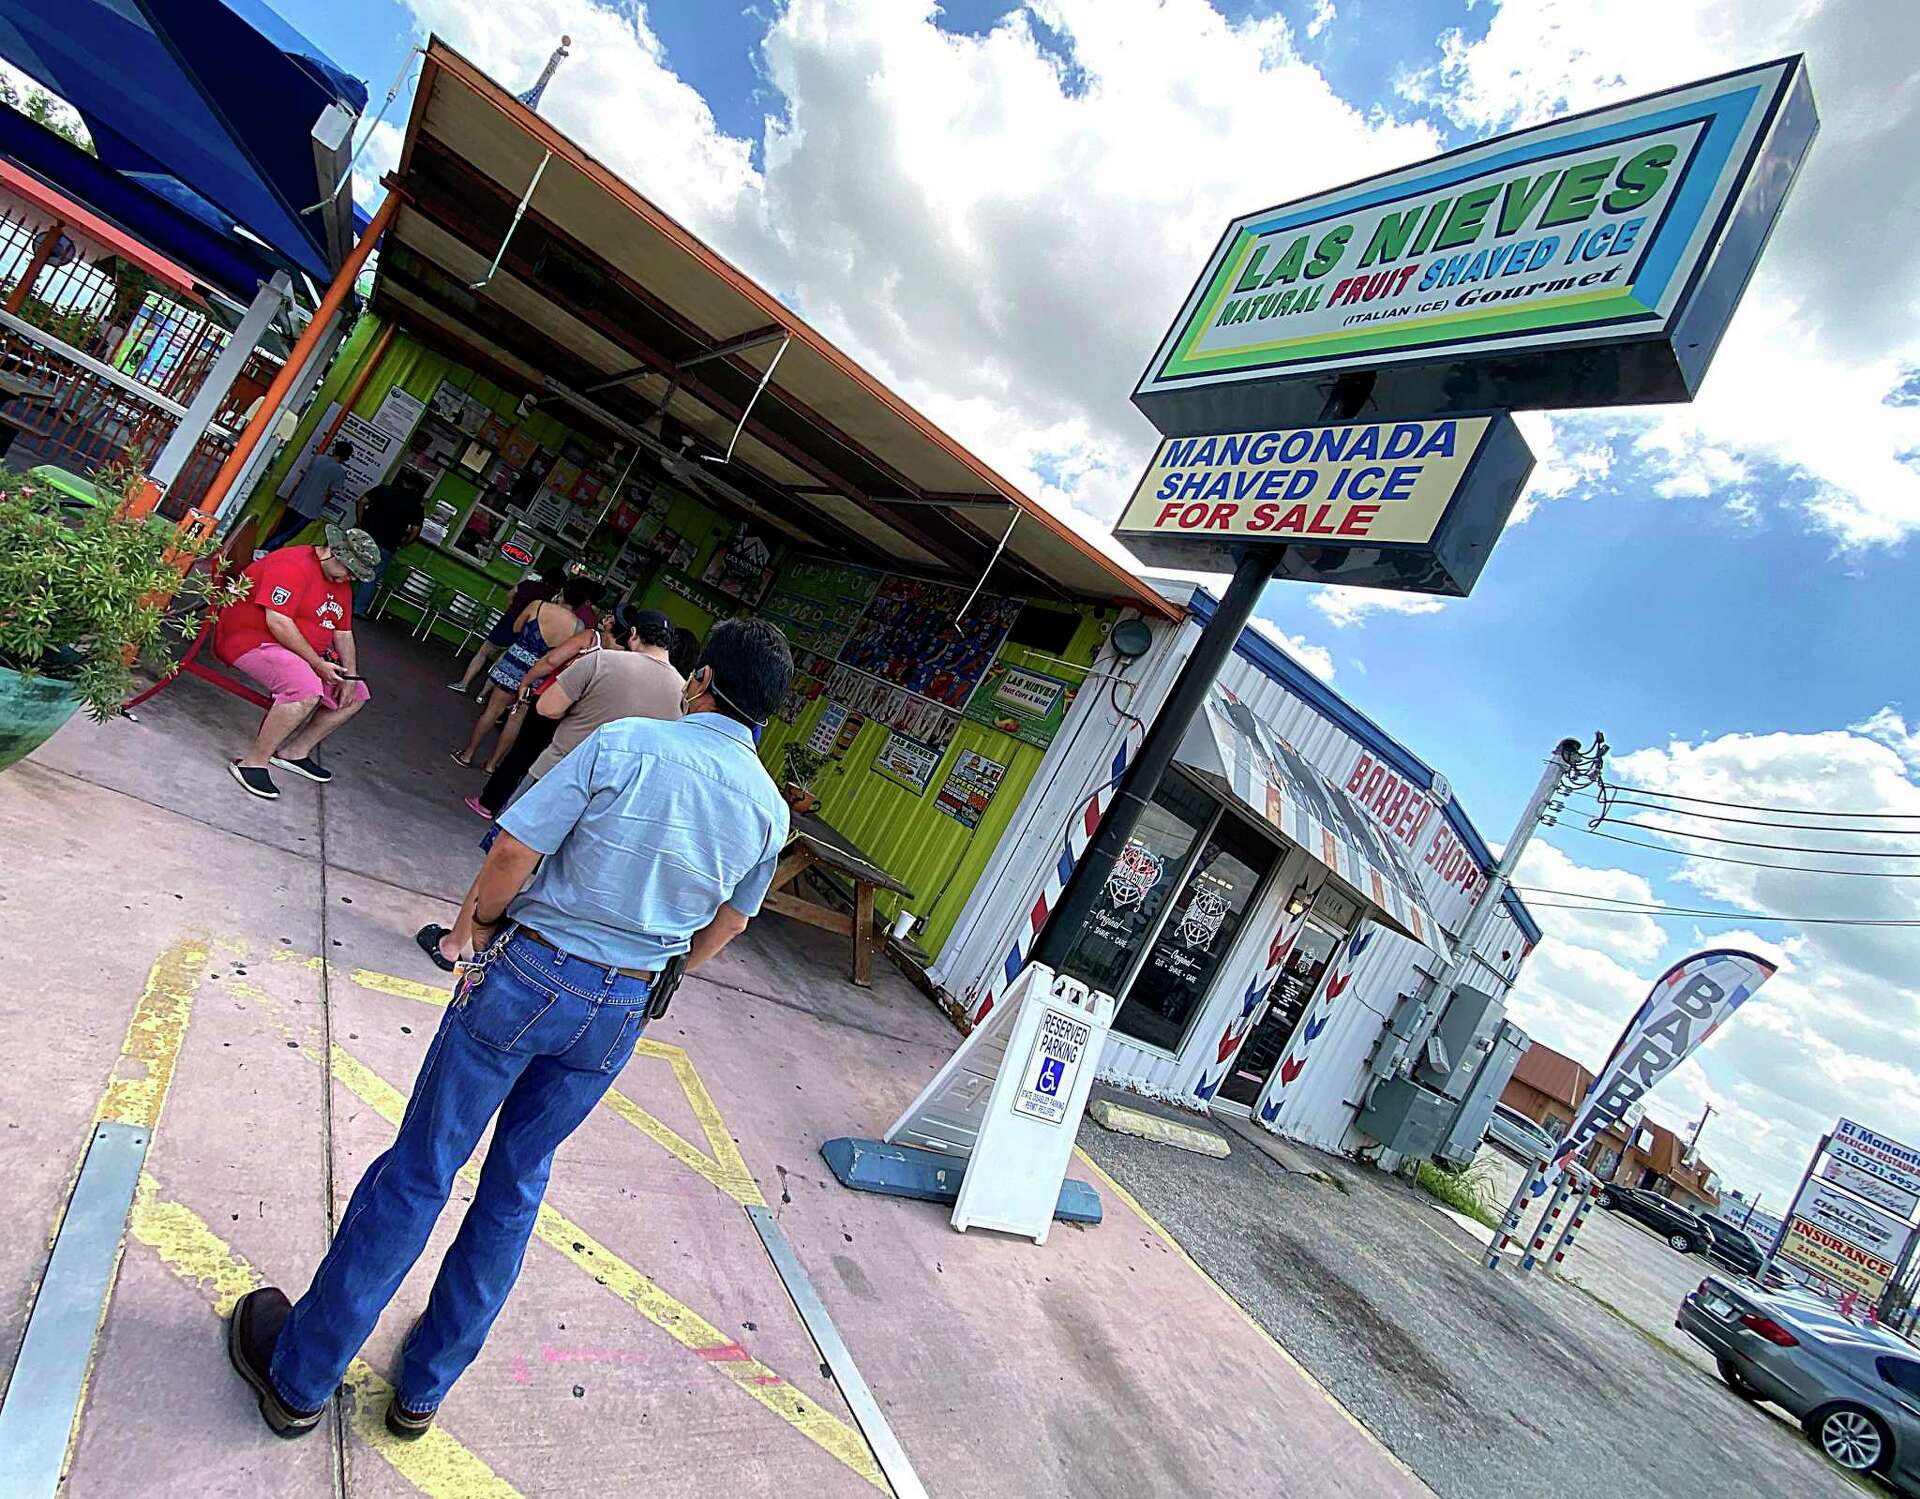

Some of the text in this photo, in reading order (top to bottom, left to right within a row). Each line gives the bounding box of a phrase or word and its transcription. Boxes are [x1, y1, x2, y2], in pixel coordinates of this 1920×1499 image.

[1233, 144, 1678, 293] LAS NIEVES
[1215, 217, 1647, 327] NATURAL FRUIT SHAVED ICE
[1343, 263, 1624, 327] (ITALIAN ICE) Gourmet
[1160, 421, 1457, 468] MANGONADA
[1156, 466, 1424, 501] SHAVED ICE
[1154, 503, 1381, 536] FOR SALE
[502, 544, 532, 563] OPEN
[1006, 674, 1057, 698] LAS NIEVES
[891, 735, 905, 747] LAS
[905, 741, 936, 761] NIEVES
[949, 774, 991, 800] SPECIAL
[1346, 754, 1433, 848] BARBER
[1096, 909, 1124, 931] Original
[1155, 958, 1164, 968] CUT
[1168, 964, 1183, 977] SHAVE
[1170, 949, 1195, 968] Original
[1042, 1013, 1088, 1046] RESERVED
[1039, 1034, 1078, 1063] PARKING
[1834, 1133, 1875, 1156] MEXICAN
[1841, 1122, 1857, 1135] El
[1835, 1148, 1920, 1192] 210.731.9957
[1793, 1219, 1891, 1277] INSURANCE
[1797, 1244, 1870, 1286] 210-731-9229
